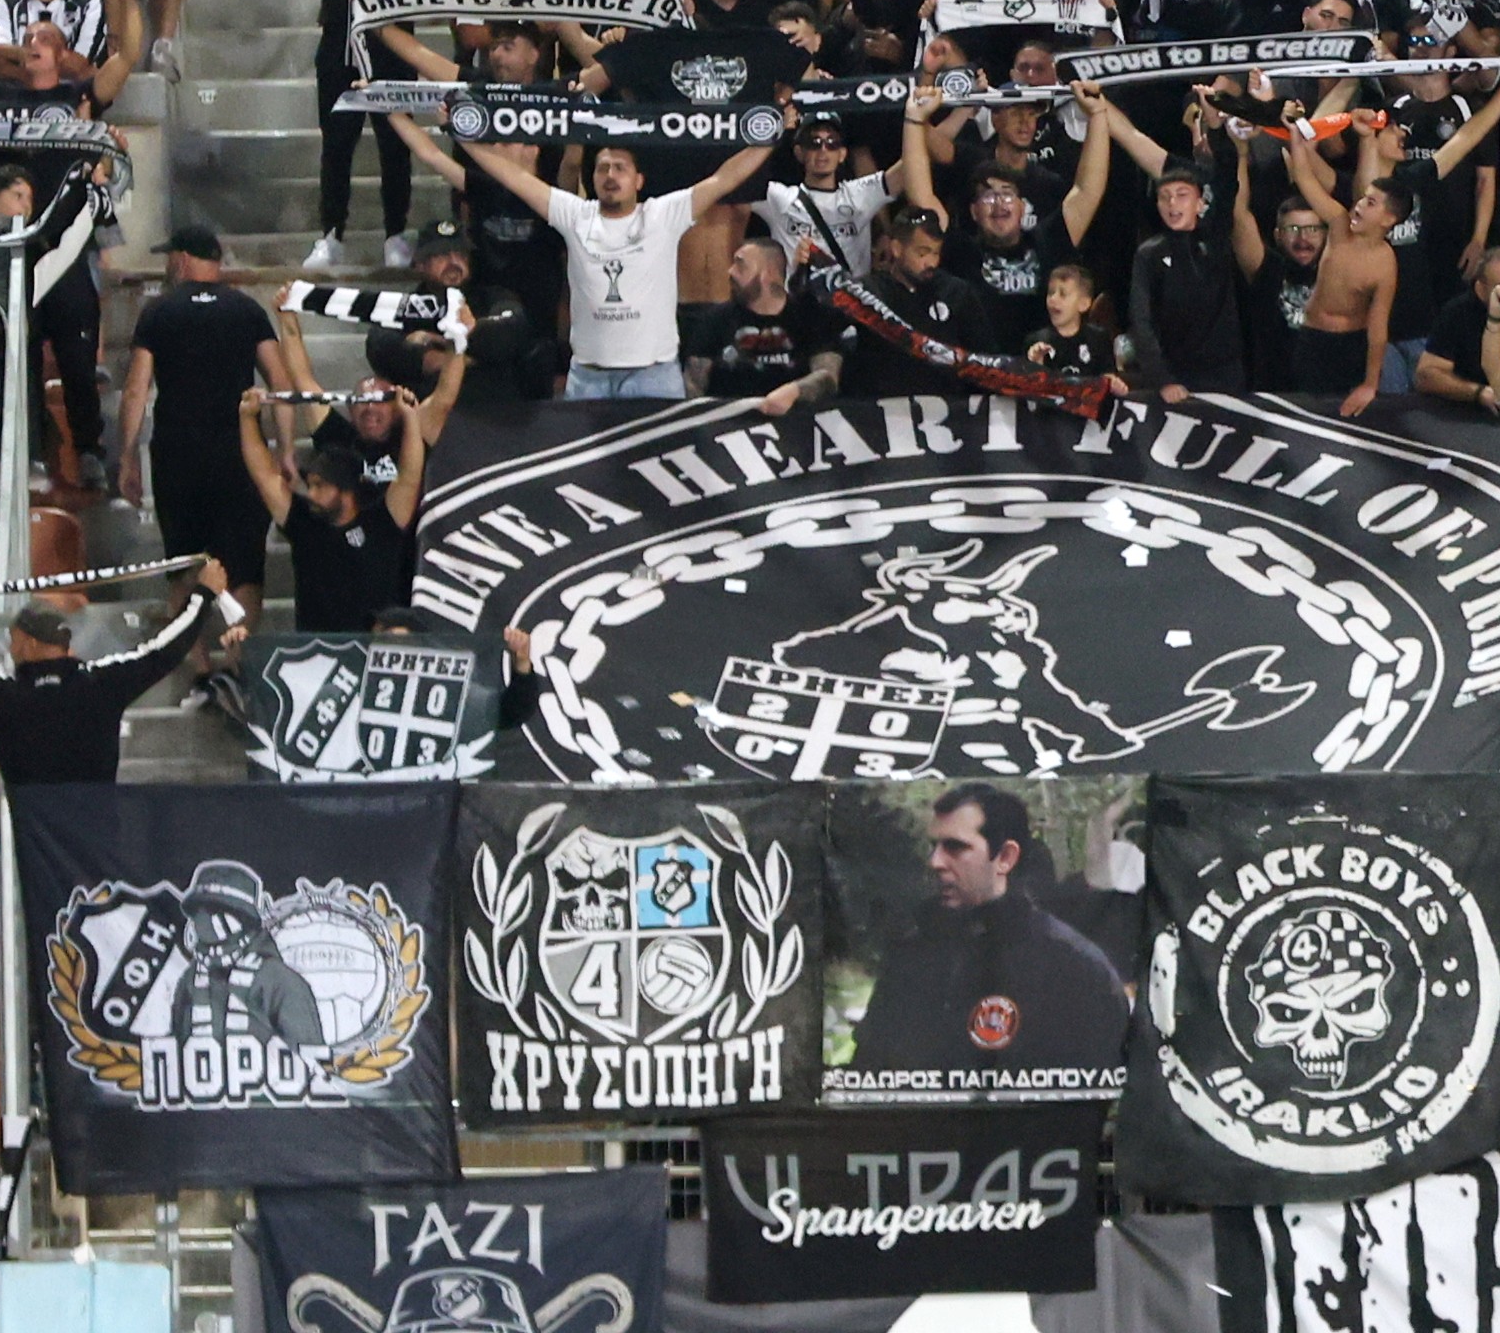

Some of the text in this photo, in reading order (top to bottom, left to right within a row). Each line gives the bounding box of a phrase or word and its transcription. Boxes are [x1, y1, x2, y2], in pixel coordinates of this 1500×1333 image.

[1072, 50, 1158, 79] proud
[1166, 46, 1202, 66] to
[1212, 42, 1249, 64] be
[492, 109, 738, 140] ΟΦΗ ΟΦΗ
[411, 503, 572, 632] HAVE
[555, 483, 643, 533] A
[626, 392, 1051, 506] HEART
[1086, 398, 1343, 506] FULL
[1355, 483, 1456, 565] OF
[374, 676, 448, 717] 2 0
[748, 690, 909, 739] 2 0
[413, 734, 439, 769] 3
[1187, 844, 1450, 943] BLACK BOYS
[1290, 930, 1318, 962] 4
[568, 941, 626, 1021] 4
[139, 1034, 348, 1109] ΠΟΡΟΣ
[486, 1030, 785, 1113] ΧΡΥΣΟΠΗΓΗ
[1205, 1064, 1439, 1138] IRAKLIO
[760, 1187, 1046, 1251] Spangenaren
